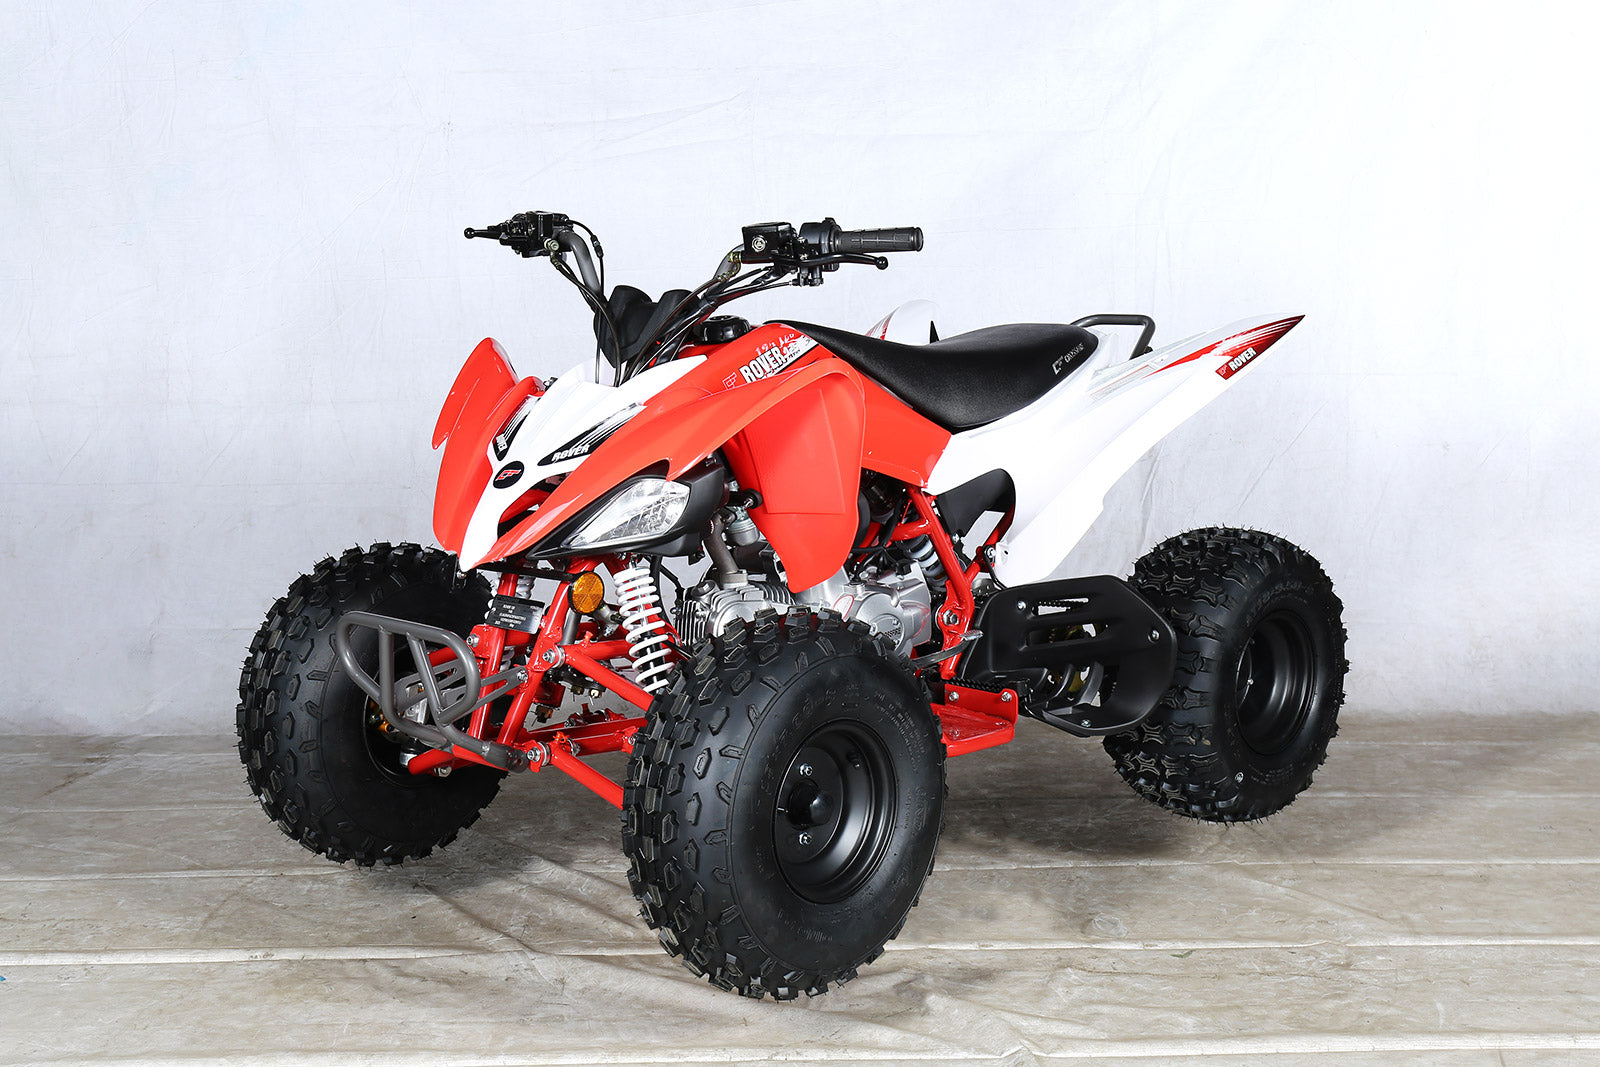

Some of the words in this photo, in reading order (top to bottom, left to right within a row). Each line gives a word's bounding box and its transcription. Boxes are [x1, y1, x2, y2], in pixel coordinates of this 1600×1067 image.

[739, 346, 786, 383] ROVER
[1227, 347, 1257, 372] ROVER
[551, 443, 590, 463] ROVER
